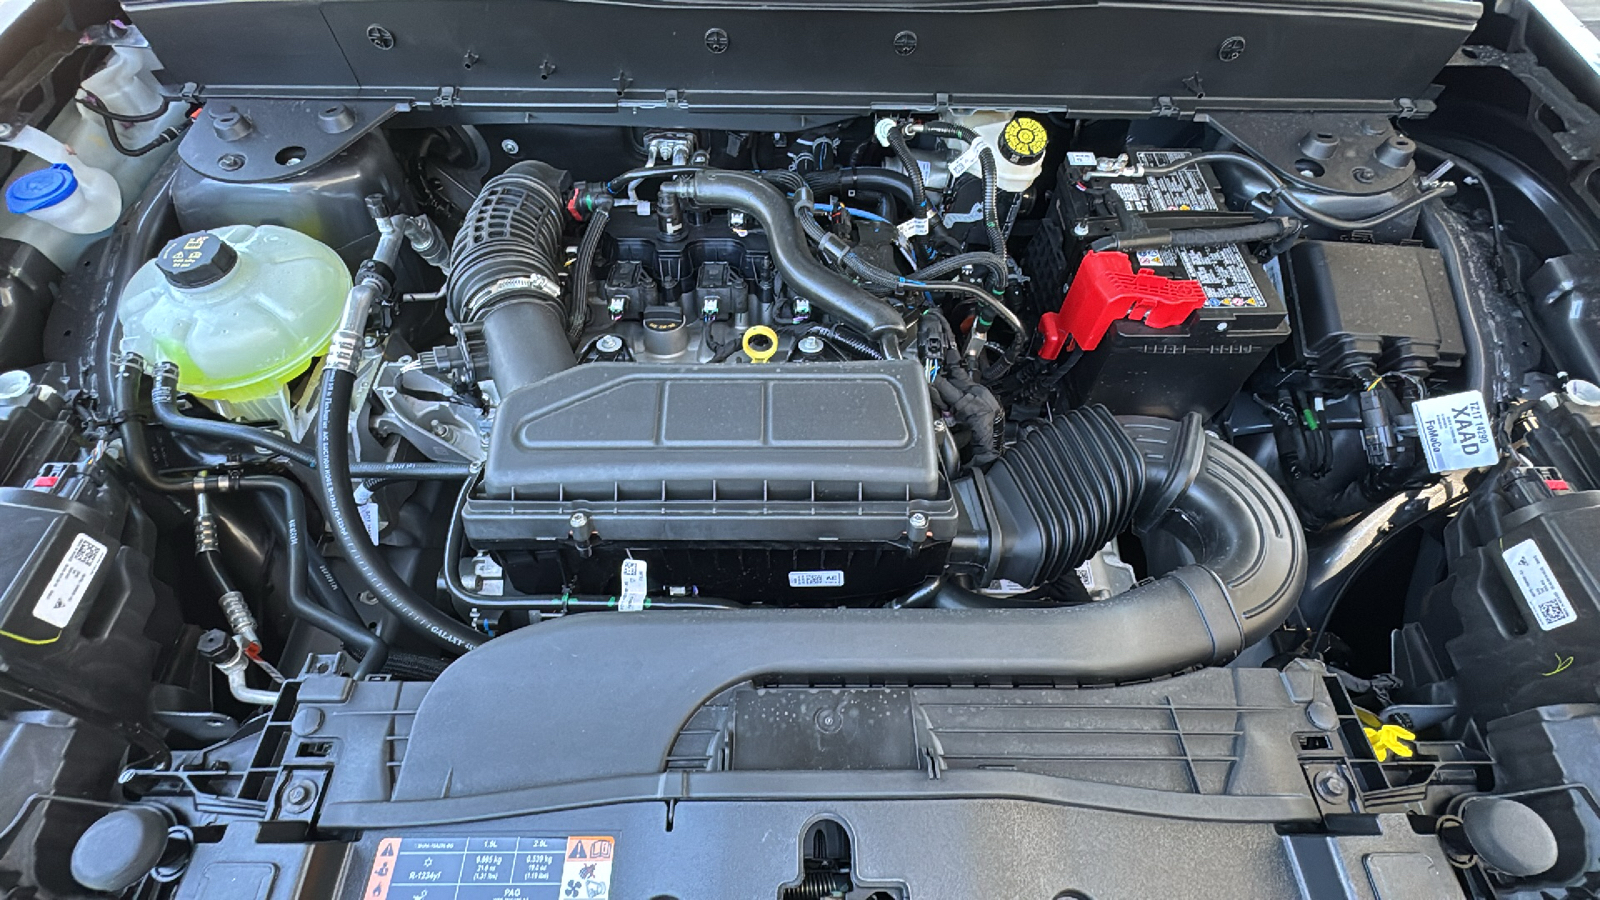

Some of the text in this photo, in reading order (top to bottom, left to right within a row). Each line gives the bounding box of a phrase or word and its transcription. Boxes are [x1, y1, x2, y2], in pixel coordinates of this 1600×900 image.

[1424, 419, 1442, 453] FoMoCo
[1451, 404, 1480, 456] XAAD
[430, 626, 465, 646] GALAXY
[408, 871, 442, 881] R-1234yf
